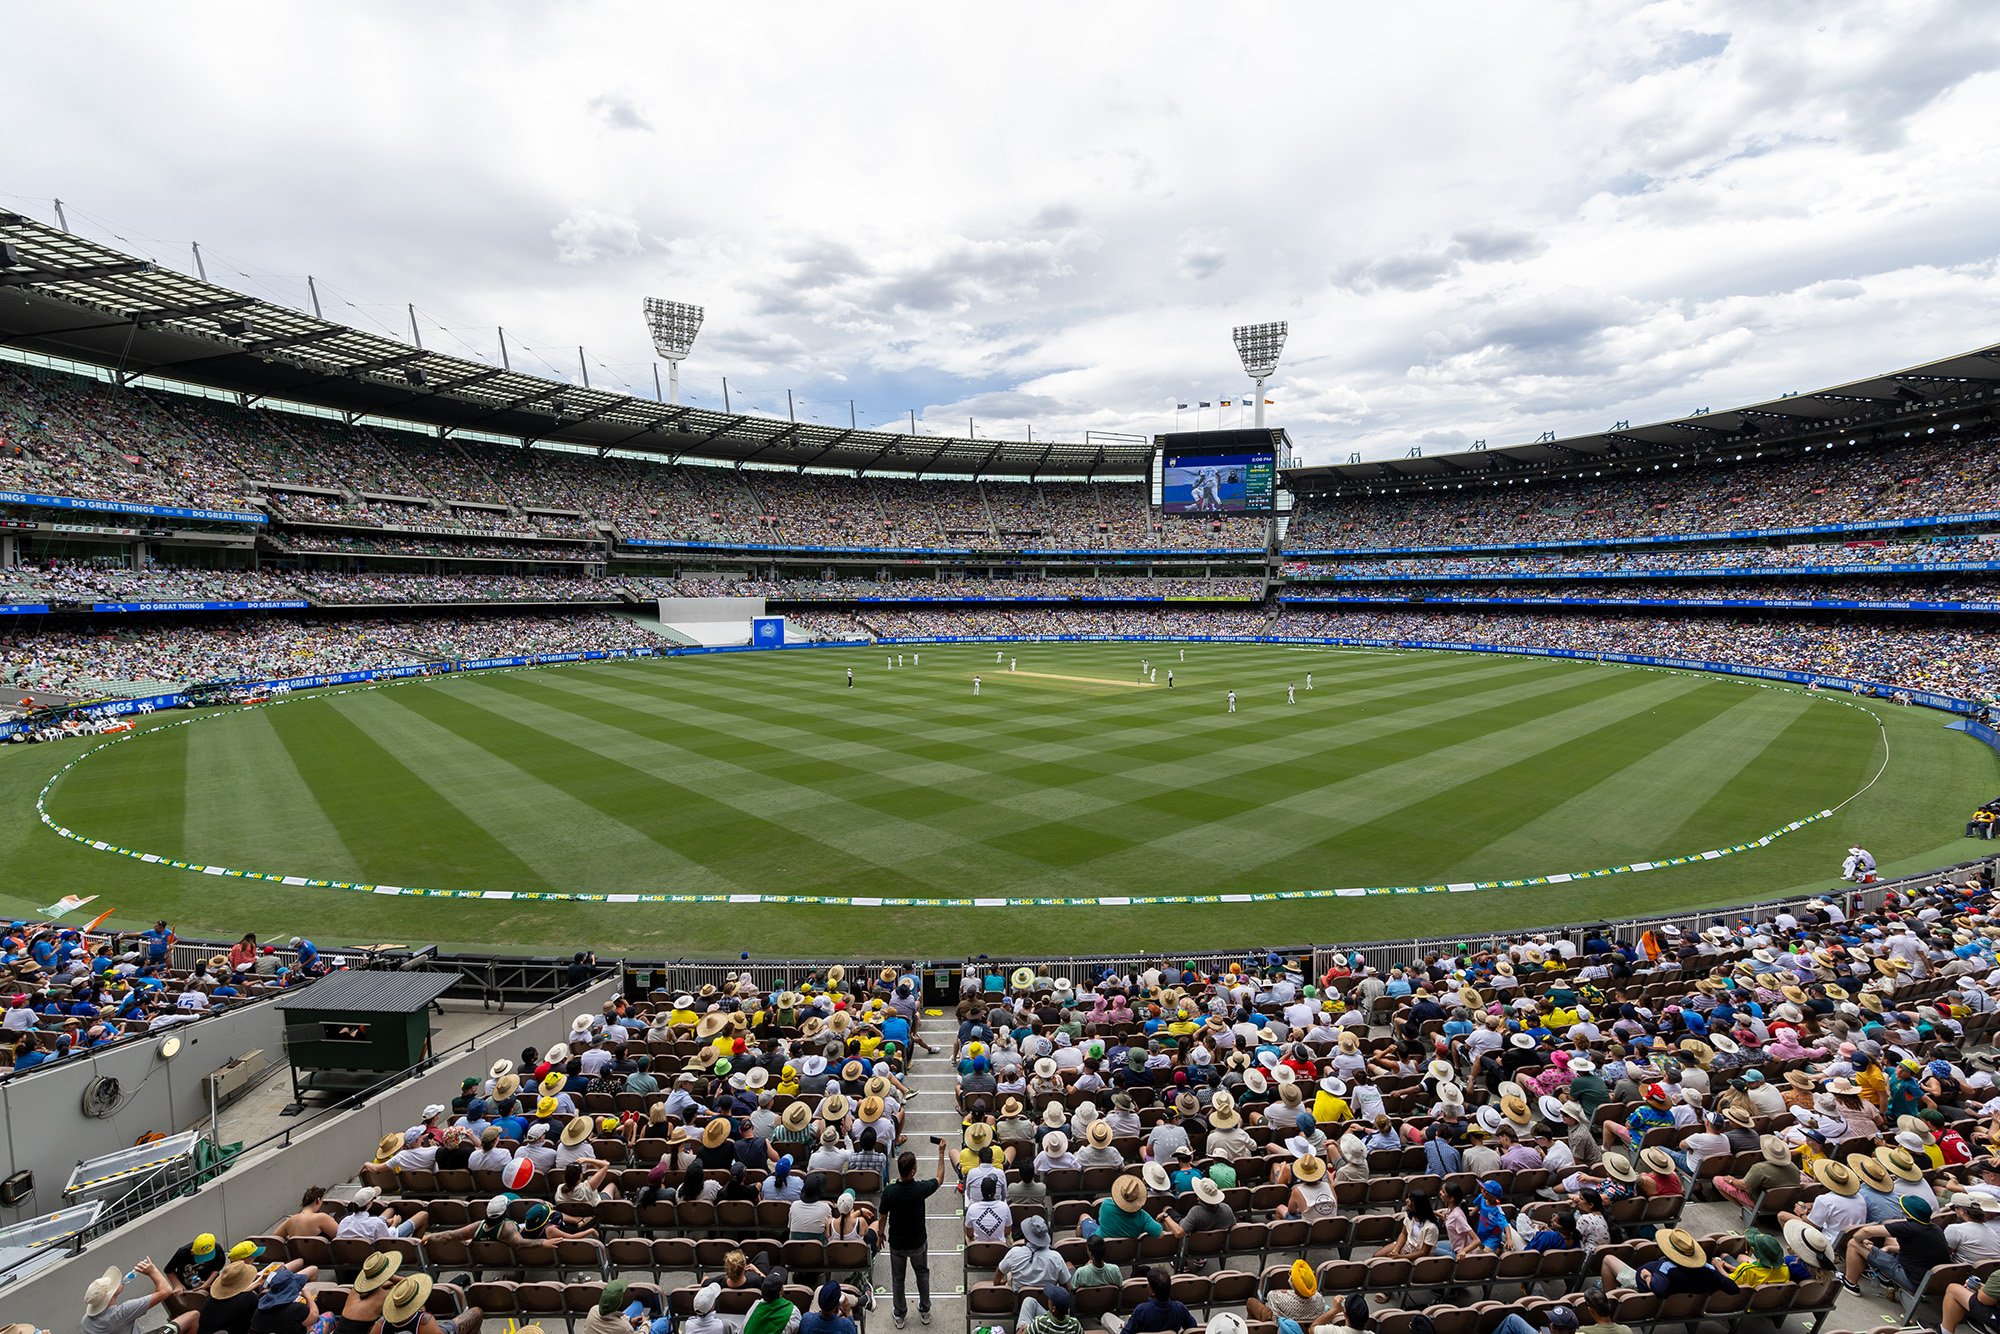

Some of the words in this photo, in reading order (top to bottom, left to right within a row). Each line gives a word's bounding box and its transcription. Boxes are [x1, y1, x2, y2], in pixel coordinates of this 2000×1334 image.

[71, 500, 86, 508] DO
[88, 501, 118, 510] GREAT
[121, 504, 154, 513] THINGS
[207, 512, 232, 520] GREAT
[235, 514, 263, 522] THINGS
[1948, 514, 1972, 522] GREAT
[1790, 526, 1813, 534] THINGS
[1854, 522, 1875, 530] GREAT
[1878, 520, 1904, 529] THINGS
[1527, 647, 1549, 655] THINGS
[1732, 665, 1741, 674] DO
[1742, 666, 1761, 676] GREAT
[1763, 669, 1787, 679] THINGS
[291, 678, 313, 688] GREAT
